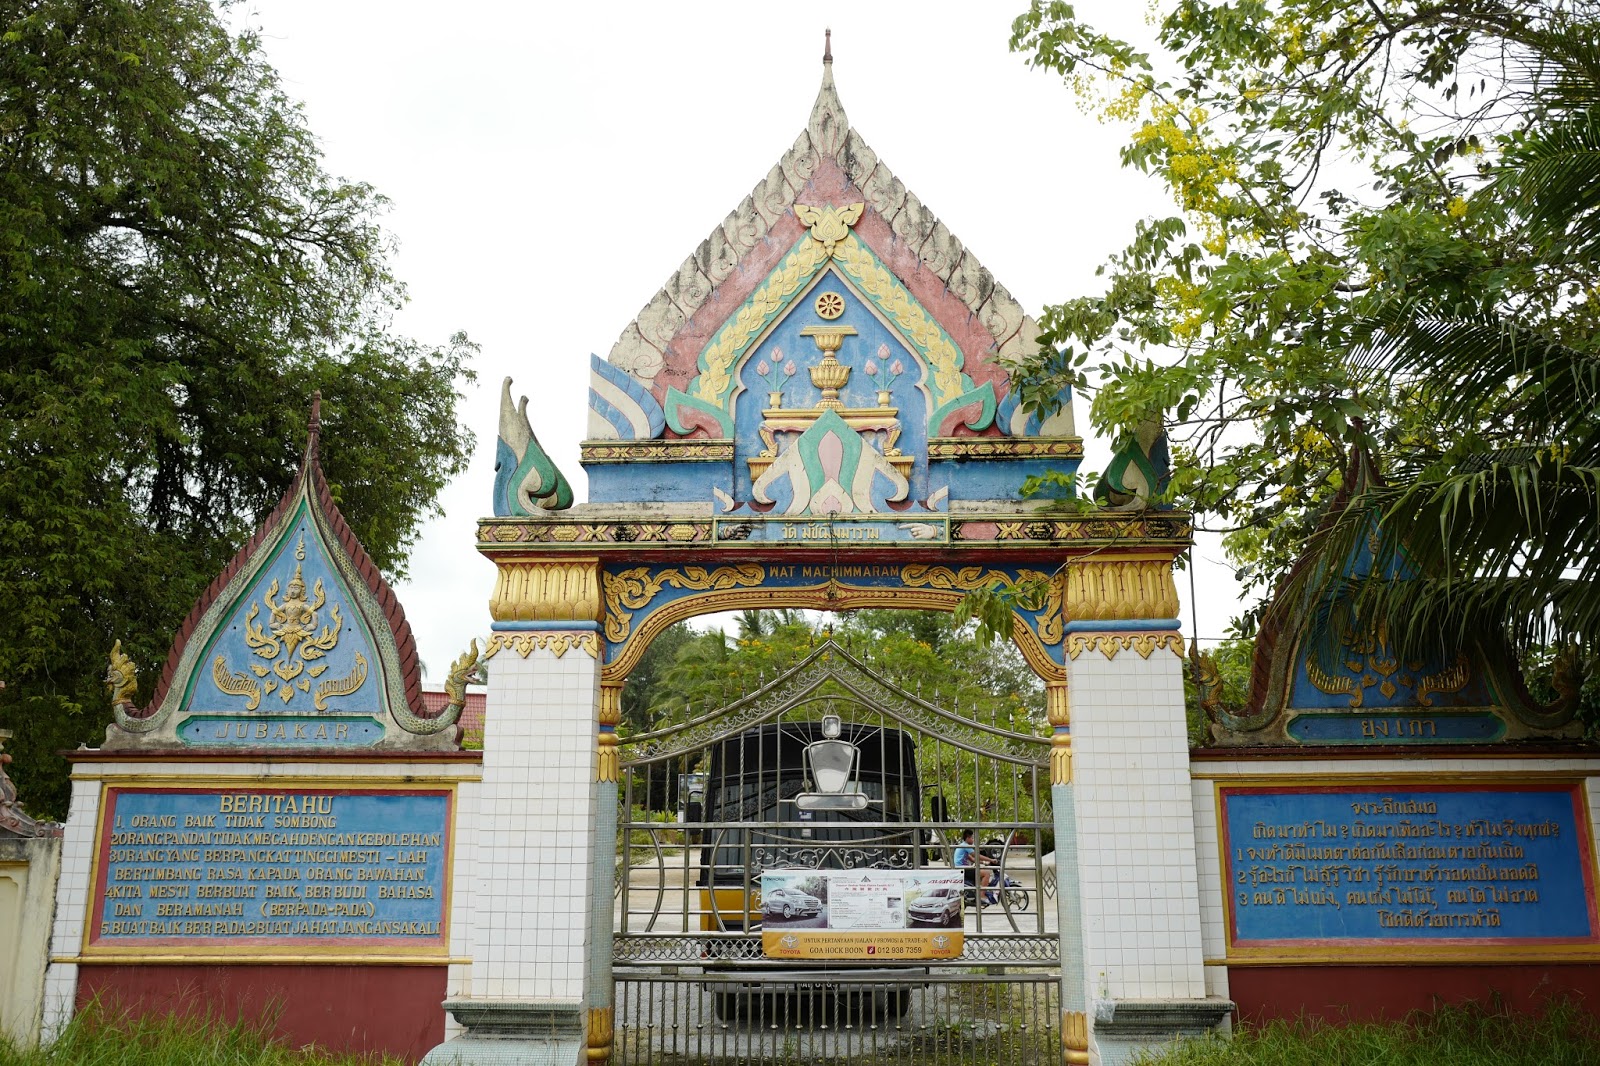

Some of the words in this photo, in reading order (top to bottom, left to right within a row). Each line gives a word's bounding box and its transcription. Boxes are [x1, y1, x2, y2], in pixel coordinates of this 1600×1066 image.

[782, 523, 797, 539] วัด
[770, 565, 796, 578] WAT
[802, 565, 900, 578] MACHIMMARAM
[214, 722, 351, 740] JUBAKAR
[132, 815, 177, 828] ORANG
[184, 815, 216, 828] BAIK
[226, 815, 265, 828] TIDAK
[274, 816, 336, 828] SOMBONG
[166, 850, 200, 862] YANG
[204, 850, 292, 863] BERPANGKAT
[339, 850, 381, 863] MESTI
[398, 850, 428, 863] LAH
[114, 867, 202, 881] BERTIMBANG
[206, 867, 244, 881] RASA
[247, 867, 301, 881] KAPADA
[306, 867, 353, 881] ORANG
[356, 867, 426, 881] BAWAHAN
[149, 885, 190, 899] MESTI
[196, 885, 257, 899] BERBUAT
[378, 885, 434, 899] BAHASA
[114, 904, 143, 917] DAN
[156, 903, 244, 917] BERAMANAH
